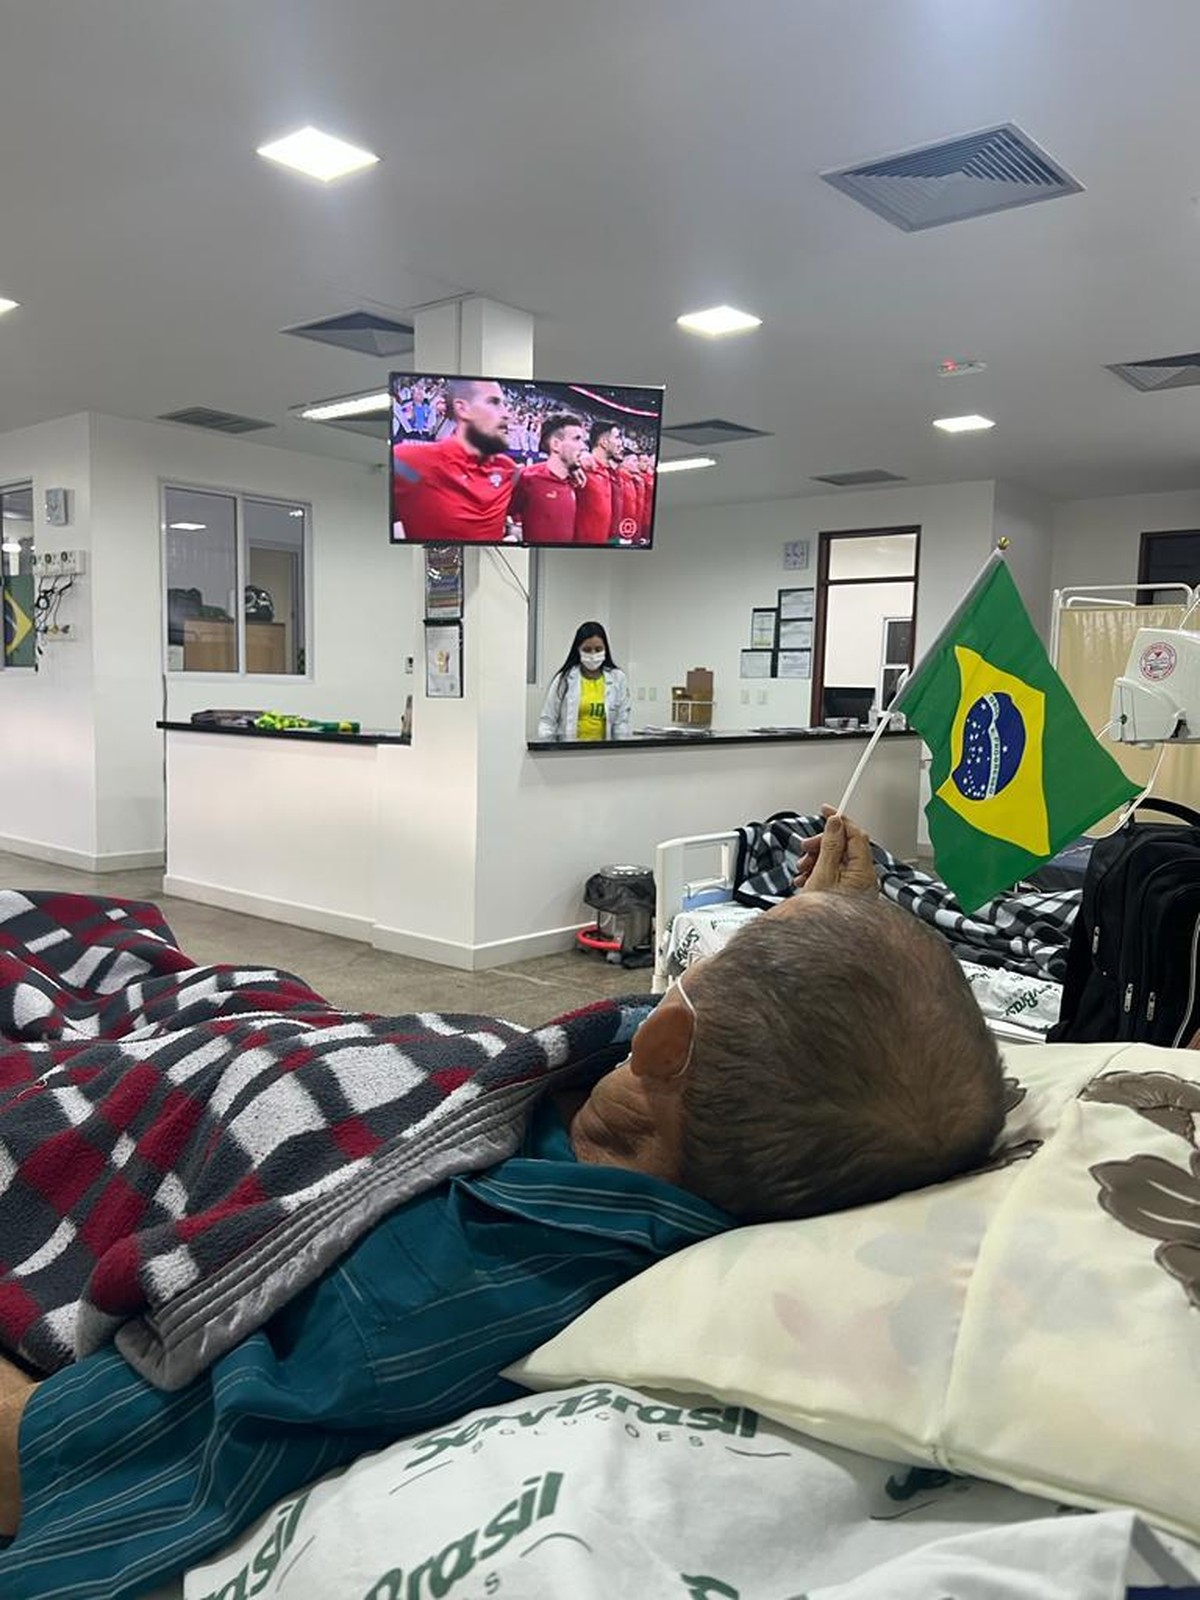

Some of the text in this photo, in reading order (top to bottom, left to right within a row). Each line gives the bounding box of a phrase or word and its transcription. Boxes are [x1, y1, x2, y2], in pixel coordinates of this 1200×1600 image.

[590, 703, 605, 717] 10
[404, 1388, 758, 1470] ServBrasil
[200, 1491, 311, 1600] asil
